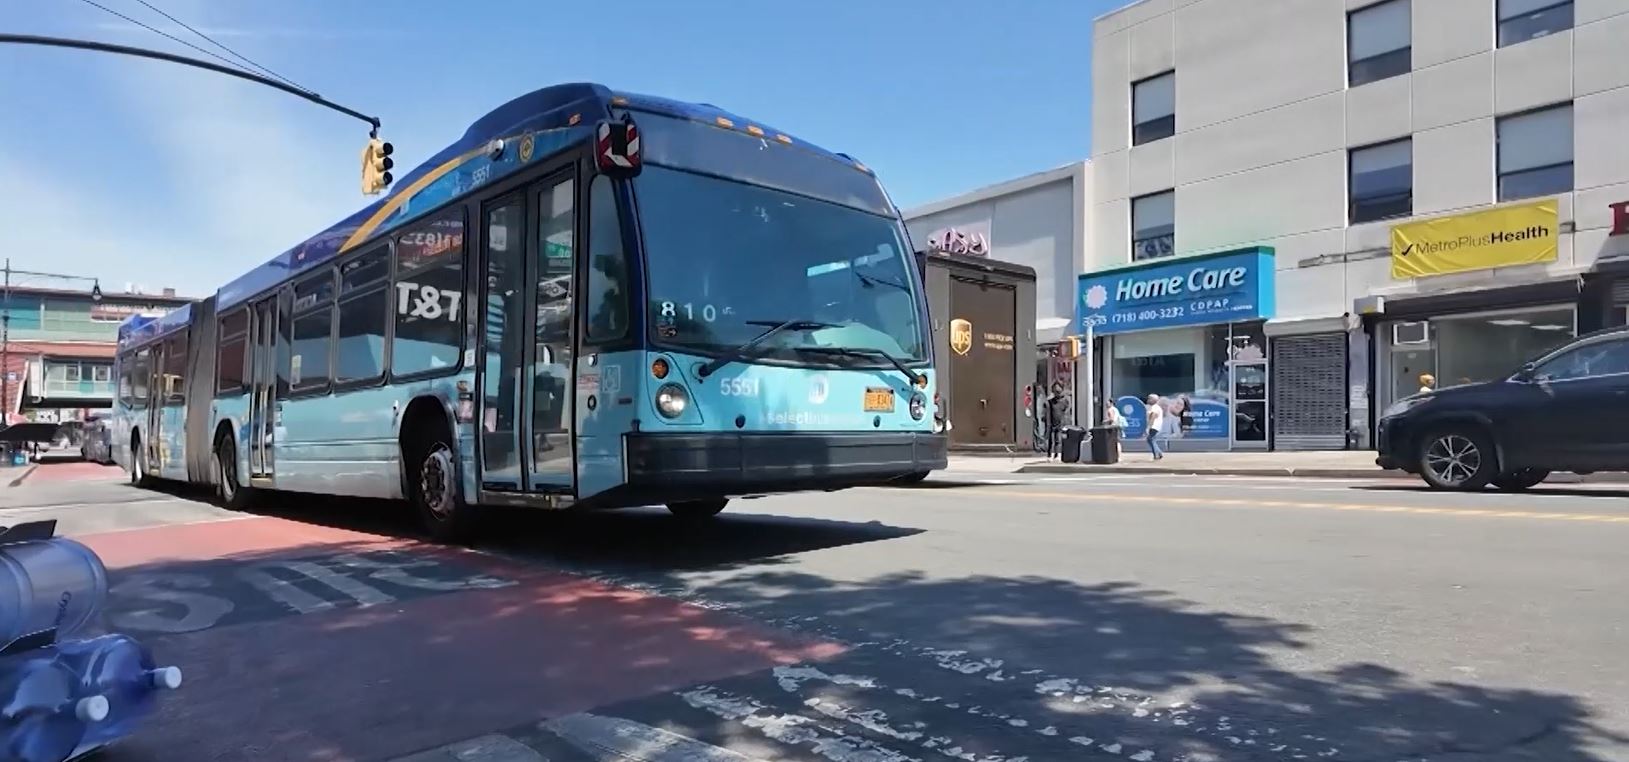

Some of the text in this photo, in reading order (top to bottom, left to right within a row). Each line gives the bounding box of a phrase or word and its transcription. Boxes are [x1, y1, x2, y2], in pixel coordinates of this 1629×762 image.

[1415, 225, 1549, 254] MetroPlusHealth
[1116, 266, 1247, 301] Home Care
[1190, 298, 1229, 311] CDPAP
[1112, 311, 1137, 323] (718)
[1138, 306, 1185, 321] 400-3232
[720, 378, 759, 397] 5551
